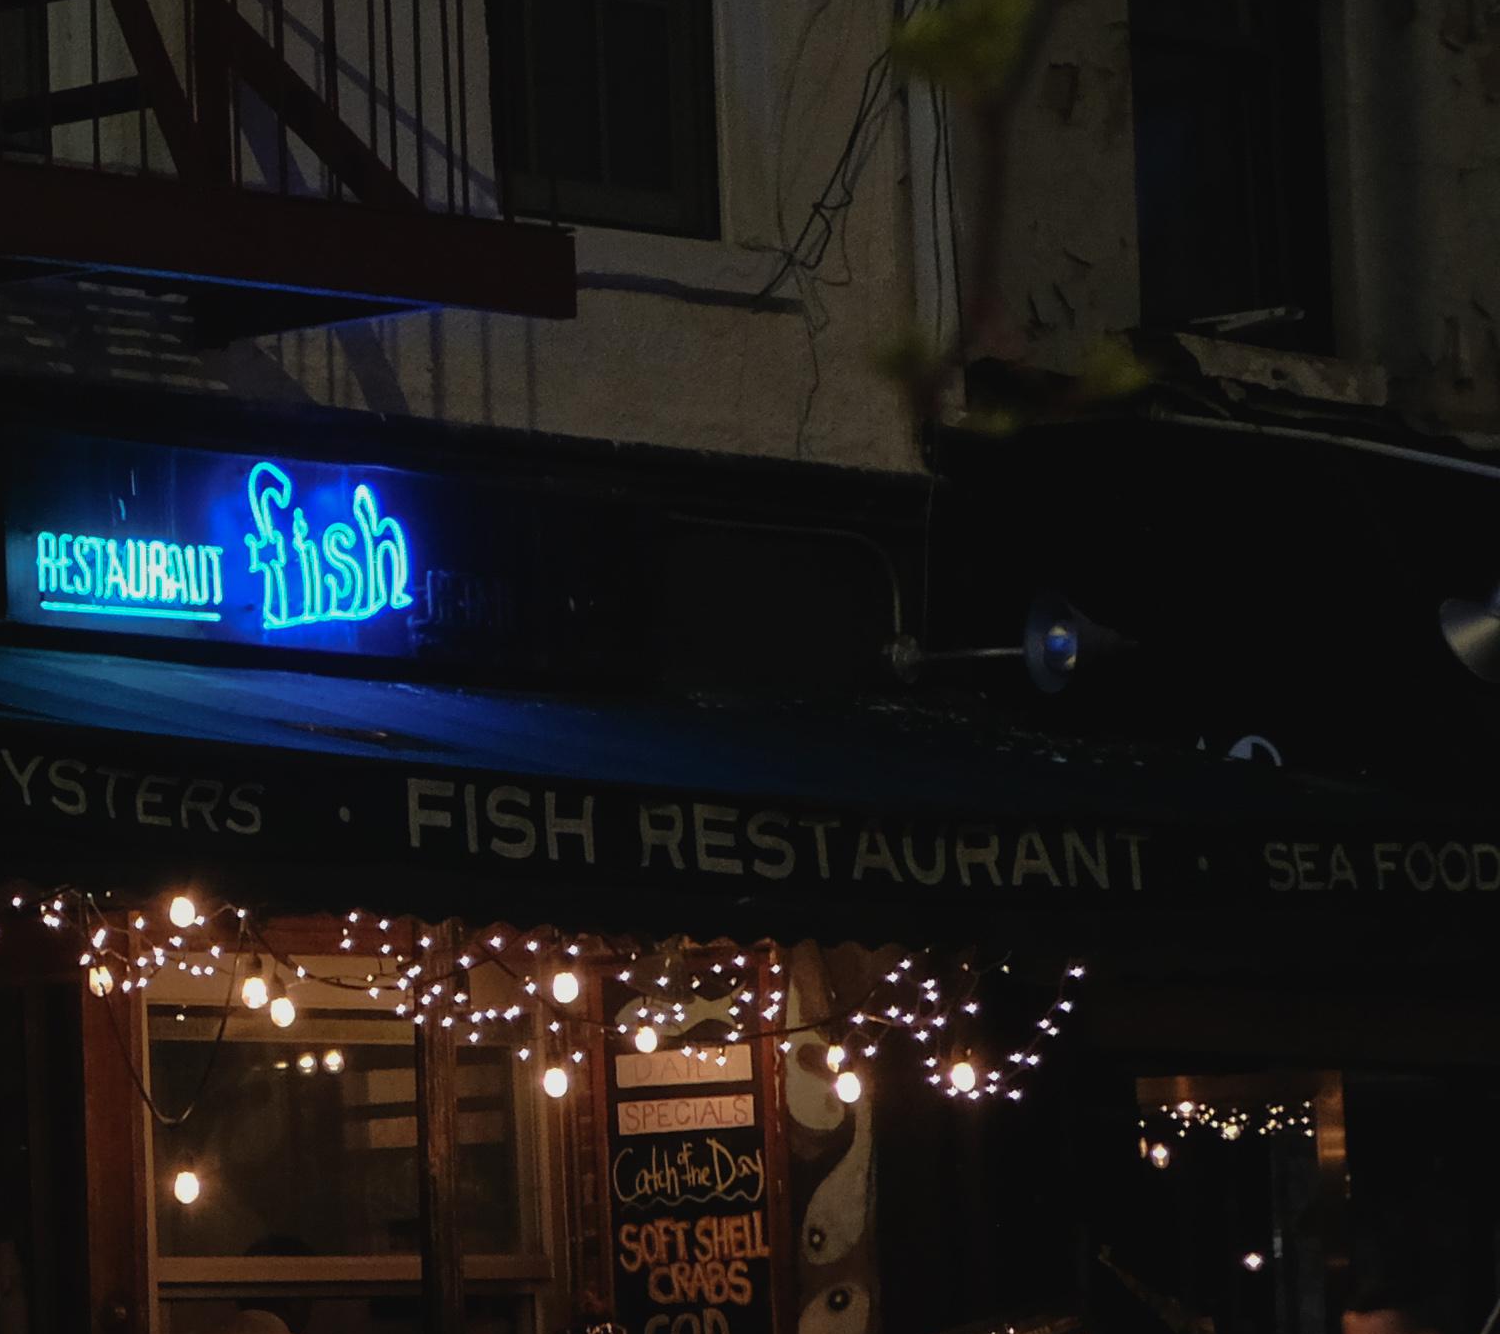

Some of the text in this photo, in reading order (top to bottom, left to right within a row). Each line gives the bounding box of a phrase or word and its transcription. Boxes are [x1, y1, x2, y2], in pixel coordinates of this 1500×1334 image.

[405, 777, 596, 865] FISH
[638, 800, 1152, 891] RESTAURANT
[1261, 841, 1358, 893] SEA
[625, 1096, 748, 1132] SPECIALS
[613, 1144, 681, 1202] Catch
[706, 1137, 765, 1202] Day
[619, 1210, 773, 1273] SOFT SHELL
[647, 1259, 754, 1305] CRABS
